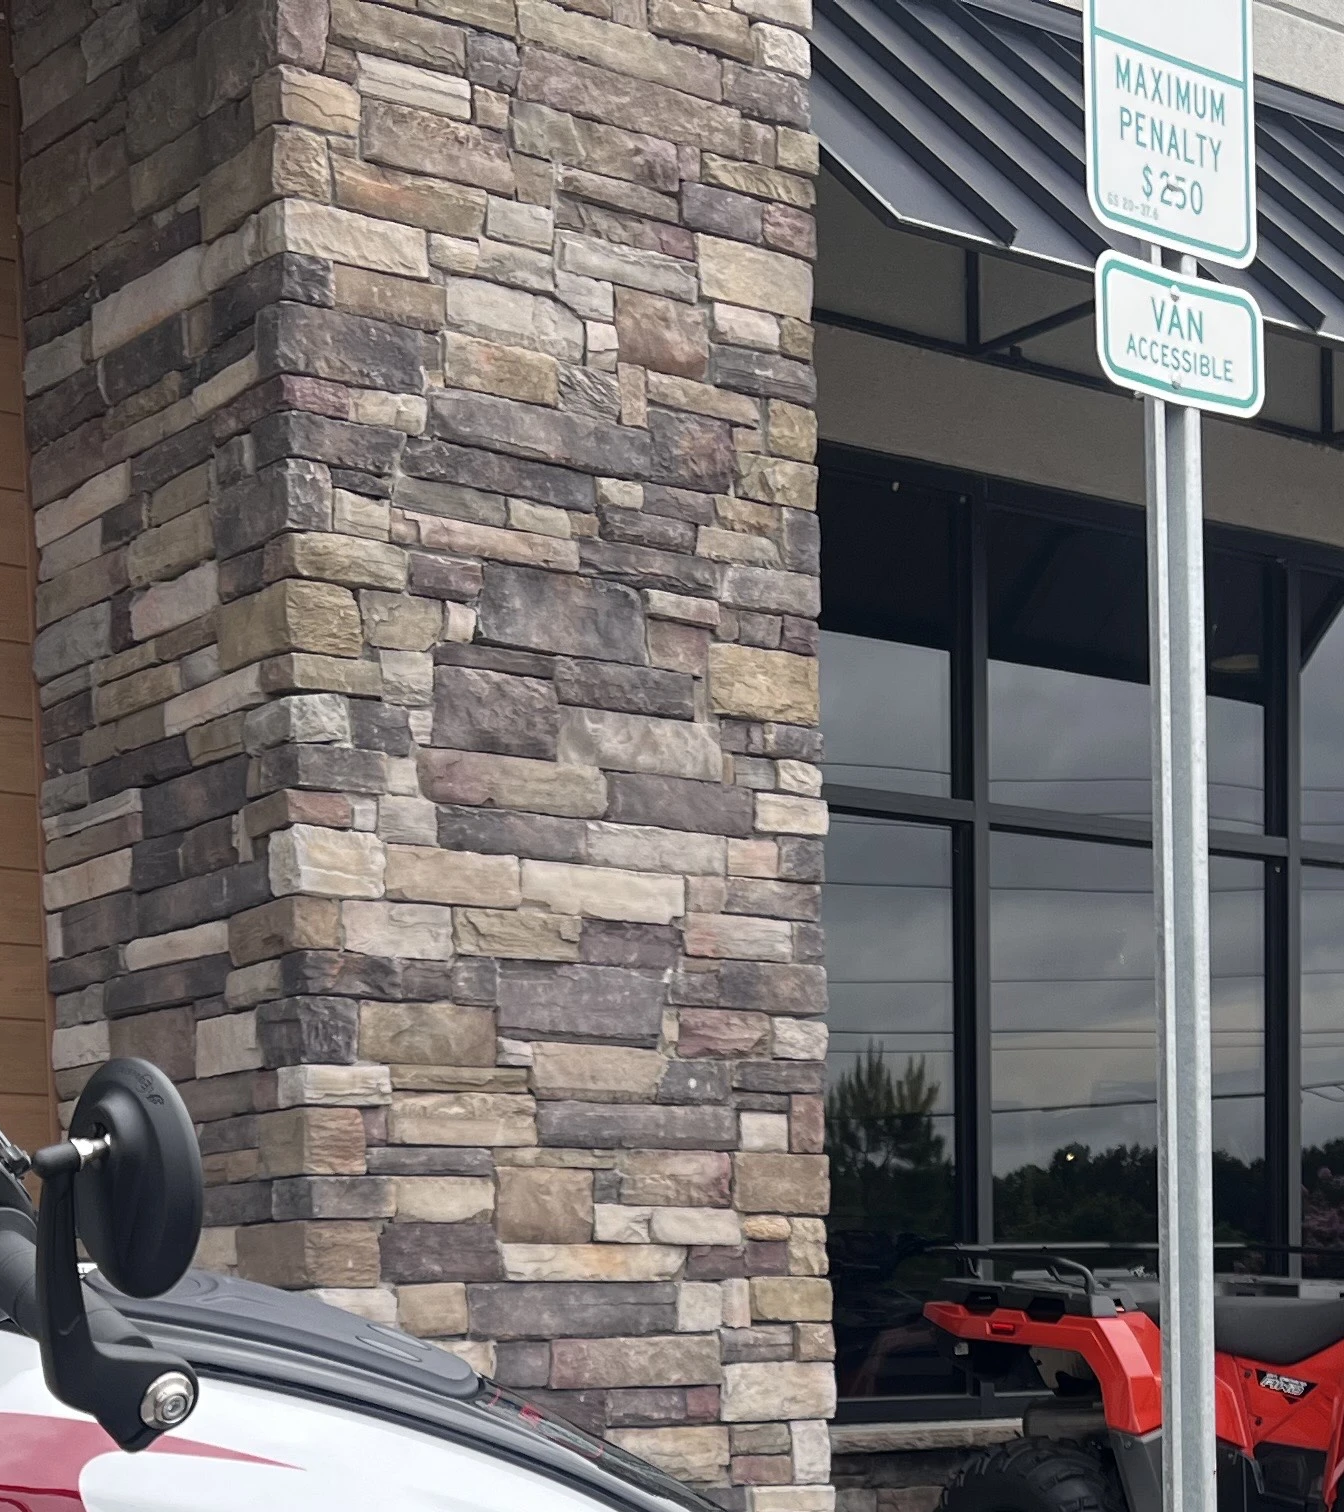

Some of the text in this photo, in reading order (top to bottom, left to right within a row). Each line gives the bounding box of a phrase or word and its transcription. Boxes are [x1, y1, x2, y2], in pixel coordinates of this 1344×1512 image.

[1115, 54, 1225, 126] MAXIMUM
[1119, 106, 1222, 172] PENALTY
[1151, 297, 1204, 345] VAN
[1126, 333, 1234, 383] ACCESSIBLE
